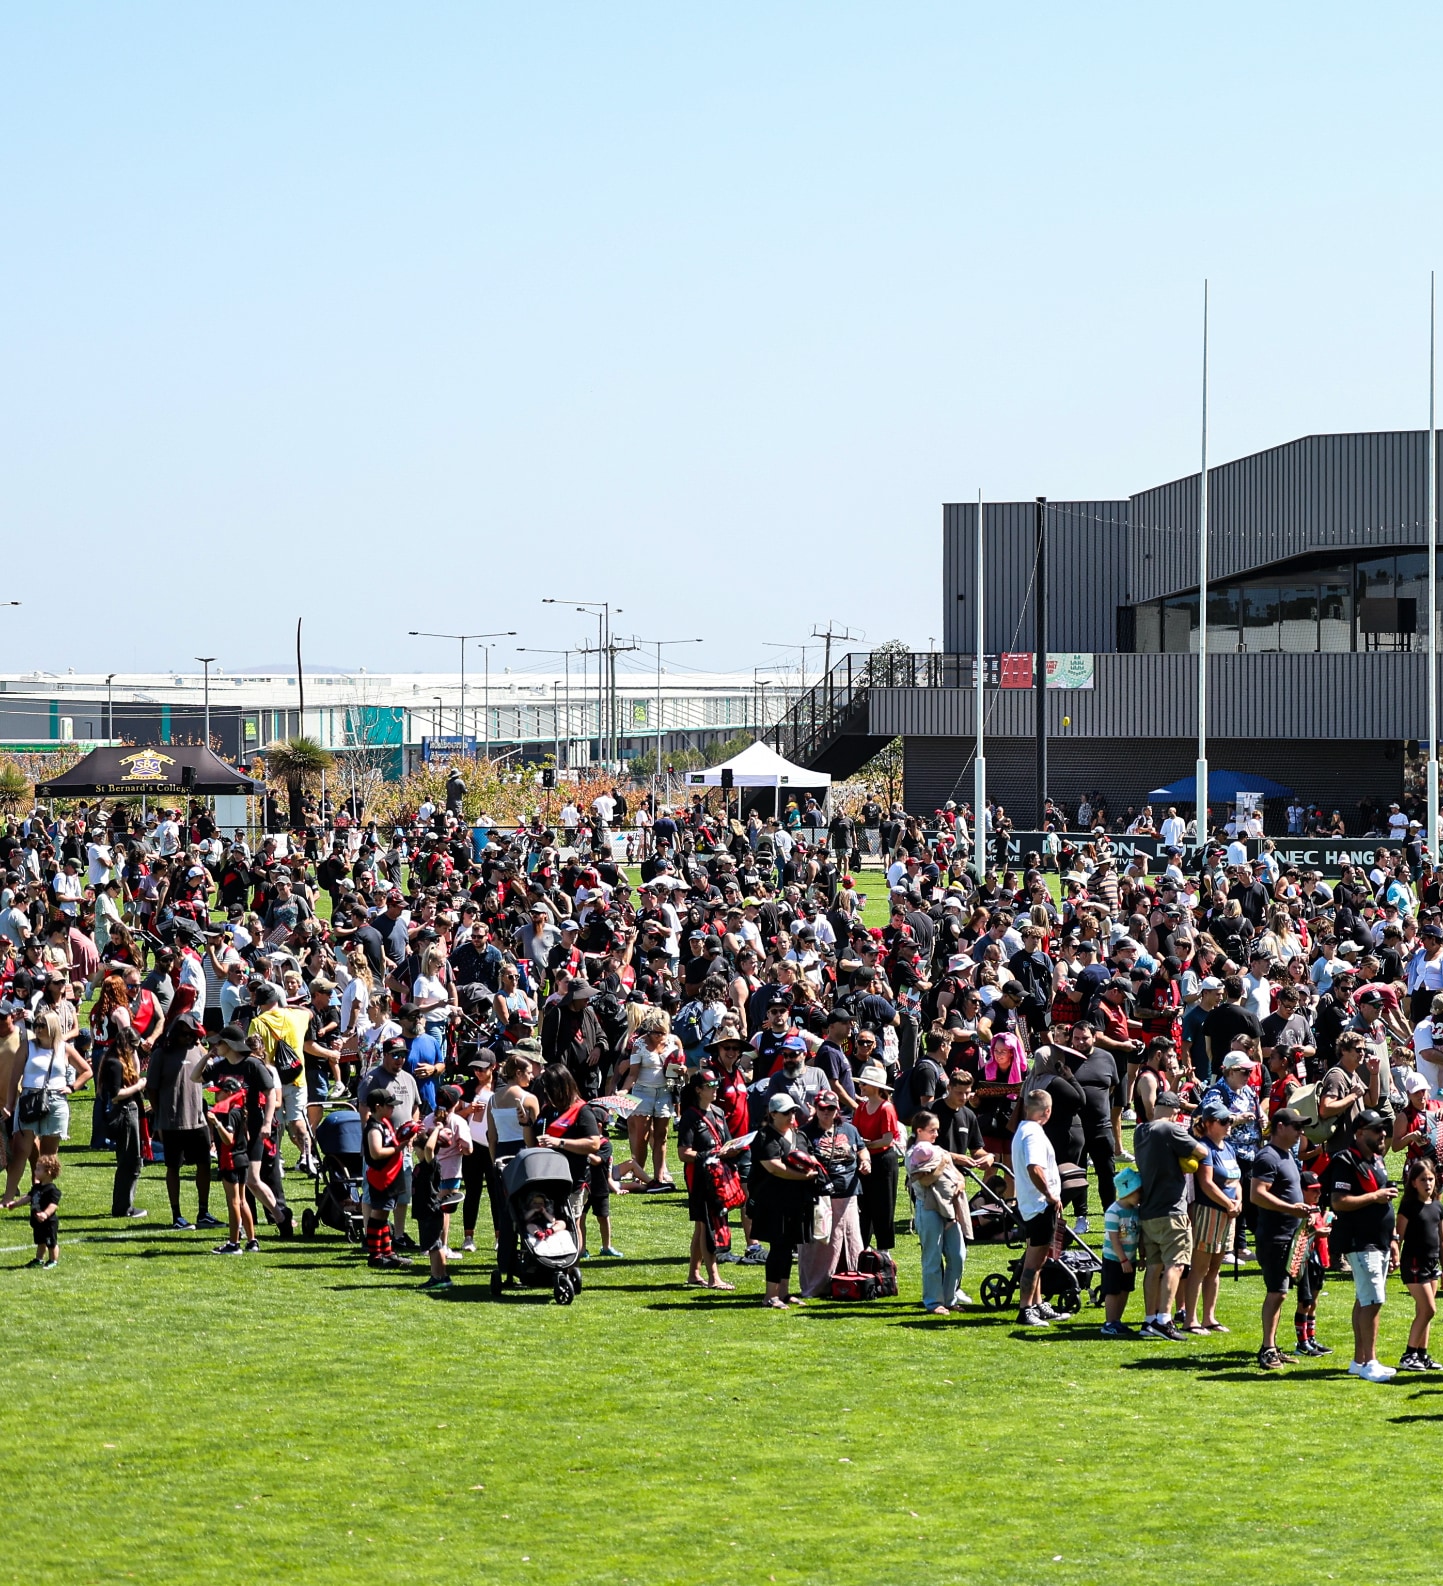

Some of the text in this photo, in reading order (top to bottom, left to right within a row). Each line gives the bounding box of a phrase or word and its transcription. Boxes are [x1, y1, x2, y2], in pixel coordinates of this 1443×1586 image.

[136, 759, 158, 769] SBC
[95, 784, 105, 793] St
[108, 783, 153, 792] Bernard's
[1274, 850, 1319, 865] NEC
